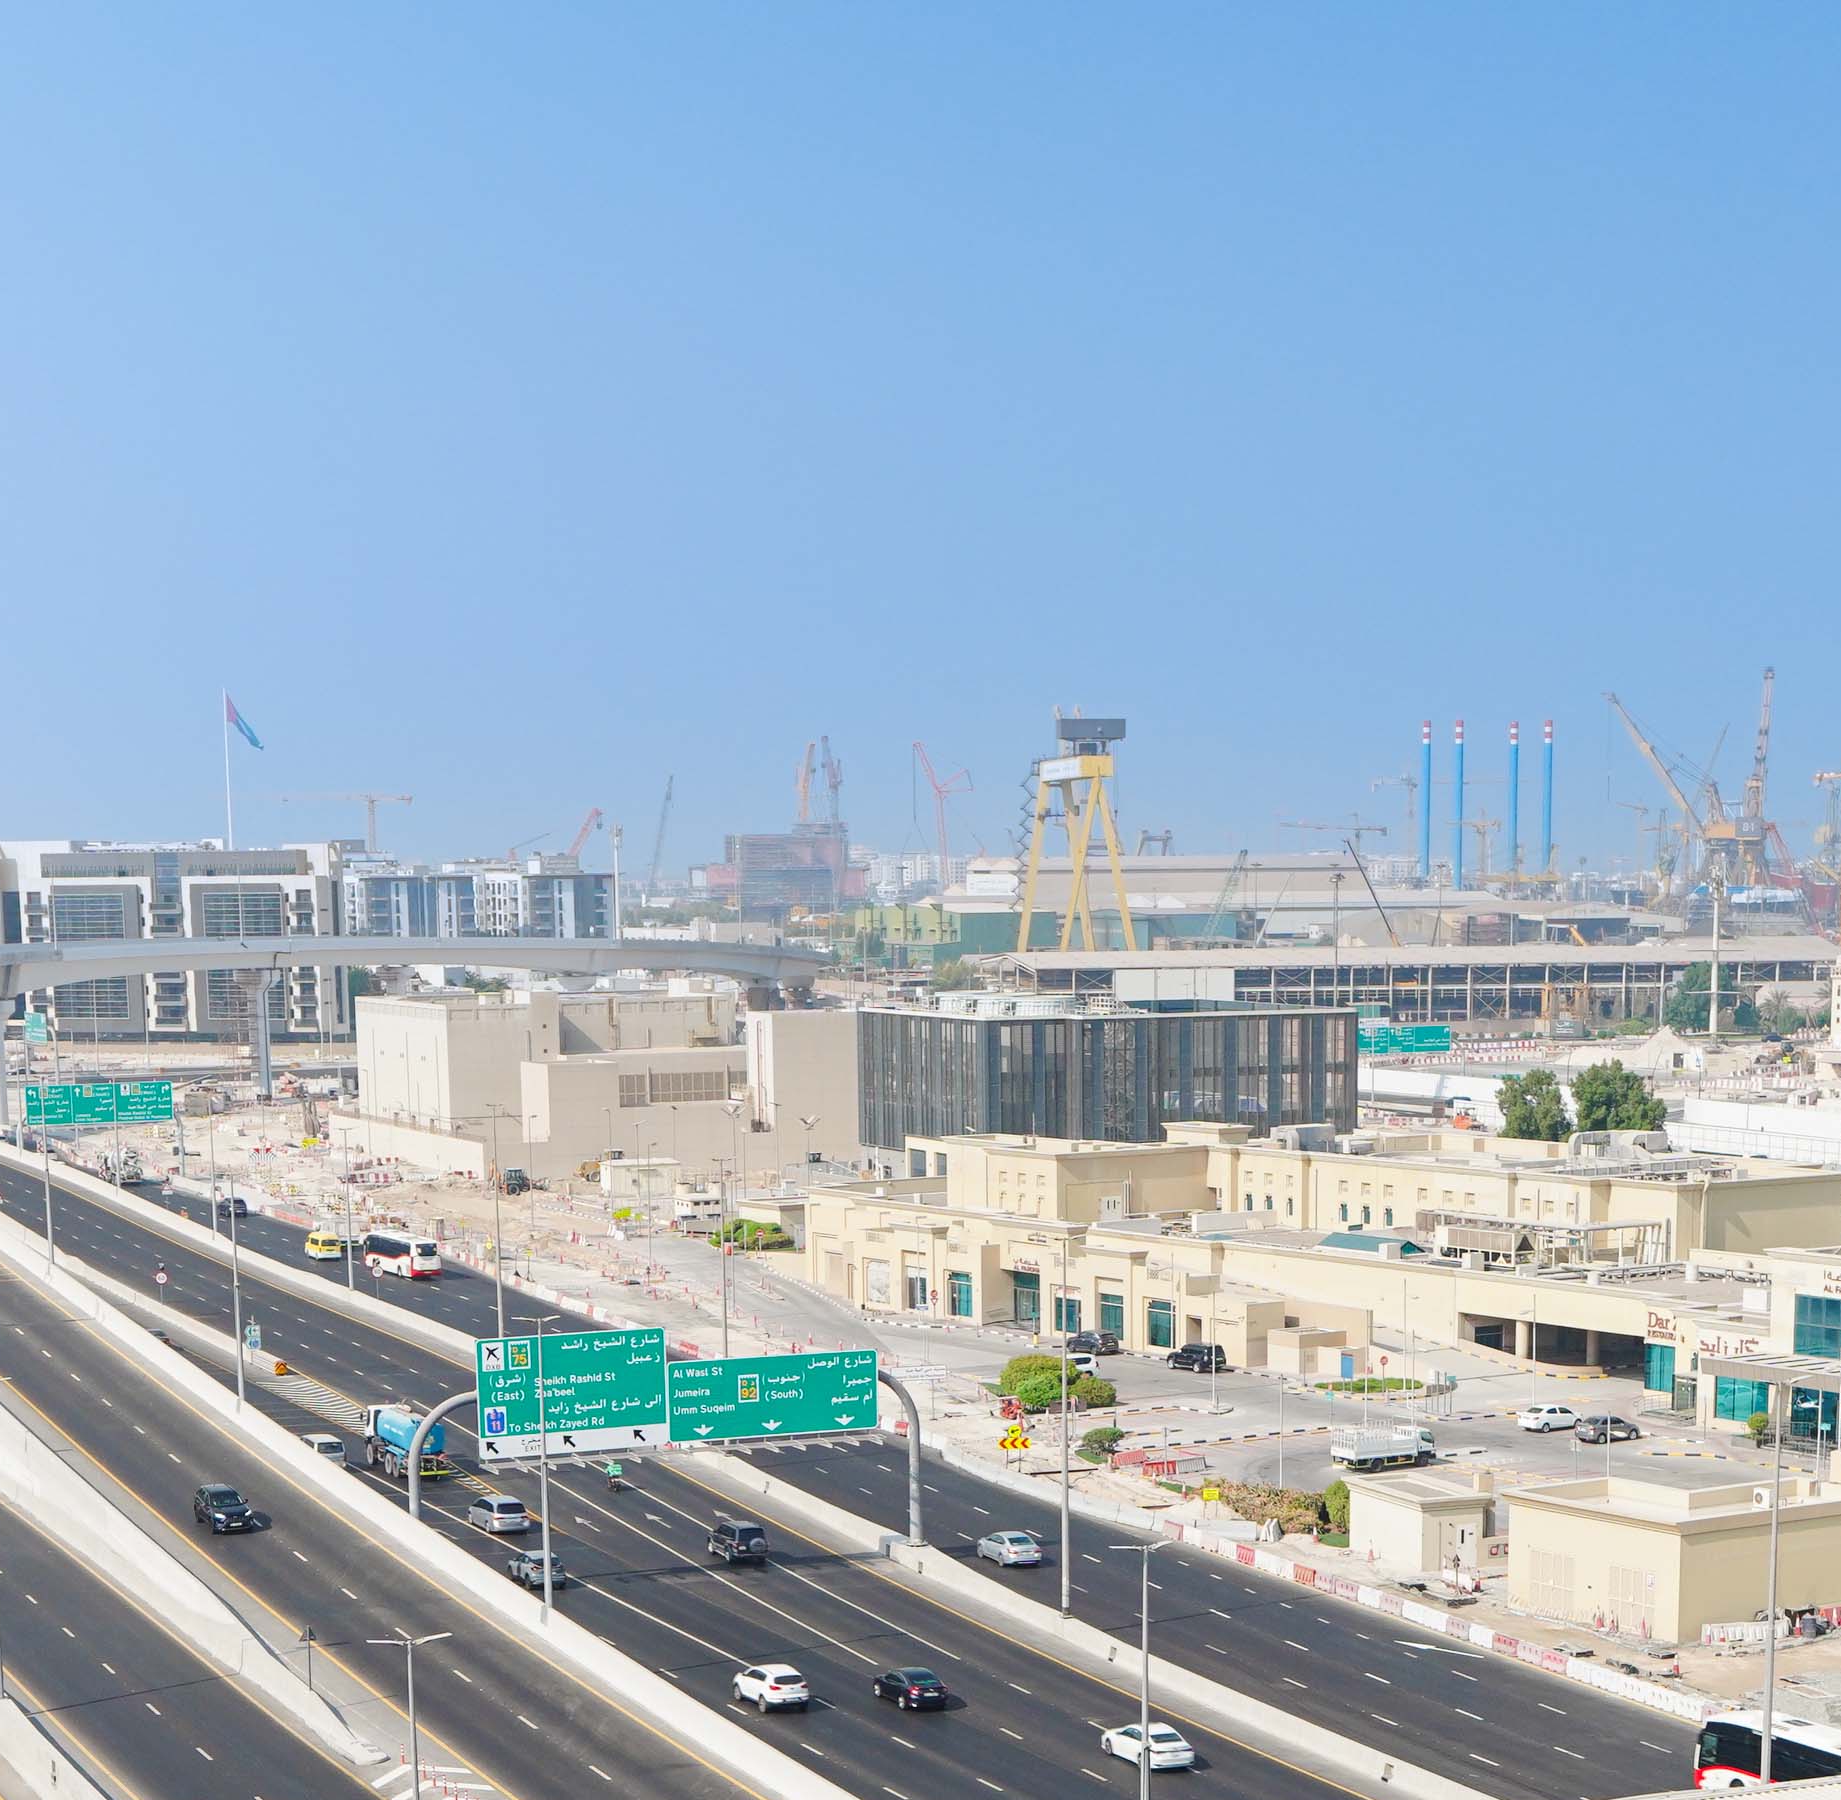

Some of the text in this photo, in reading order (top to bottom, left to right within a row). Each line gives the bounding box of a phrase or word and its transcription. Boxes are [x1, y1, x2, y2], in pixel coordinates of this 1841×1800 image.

[1824, 1284, 1833, 1293] AL
[1648, 1312, 1670, 1330] Dar
[561, 1334, 659, 1351] شارع الشيخ راشد
[1699, 1336, 1728, 1356] زايد
[512, 1354, 527, 1365] 75
[626, 1352, 660, 1364] زعبيل
[807, 1356, 872, 1369] شارع الوصل
[570, 1374, 602, 1383] Rashid
[604, 1373, 615, 1381] St
[673, 1367, 722, 1379] Al Wasl St
[842, 1375, 872, 1387] جميرا
[491, 1390, 525, 1402] (East)
[673, 1388, 710, 1398] Jumeira
[741, 1387, 756, 1398] 92
[765, 1388, 803, 1402] (South)
[612, 1398, 640, 1411] شارع
[831, 1394, 859, 1405] سقيم
[574, 1399, 606, 1413] الشيخ
[673, 1403, 735, 1415] Umm Suqeim
[491, 1421, 502, 1431] 11
[509, 1416, 604, 1432] To Shekh Zayed Rd
